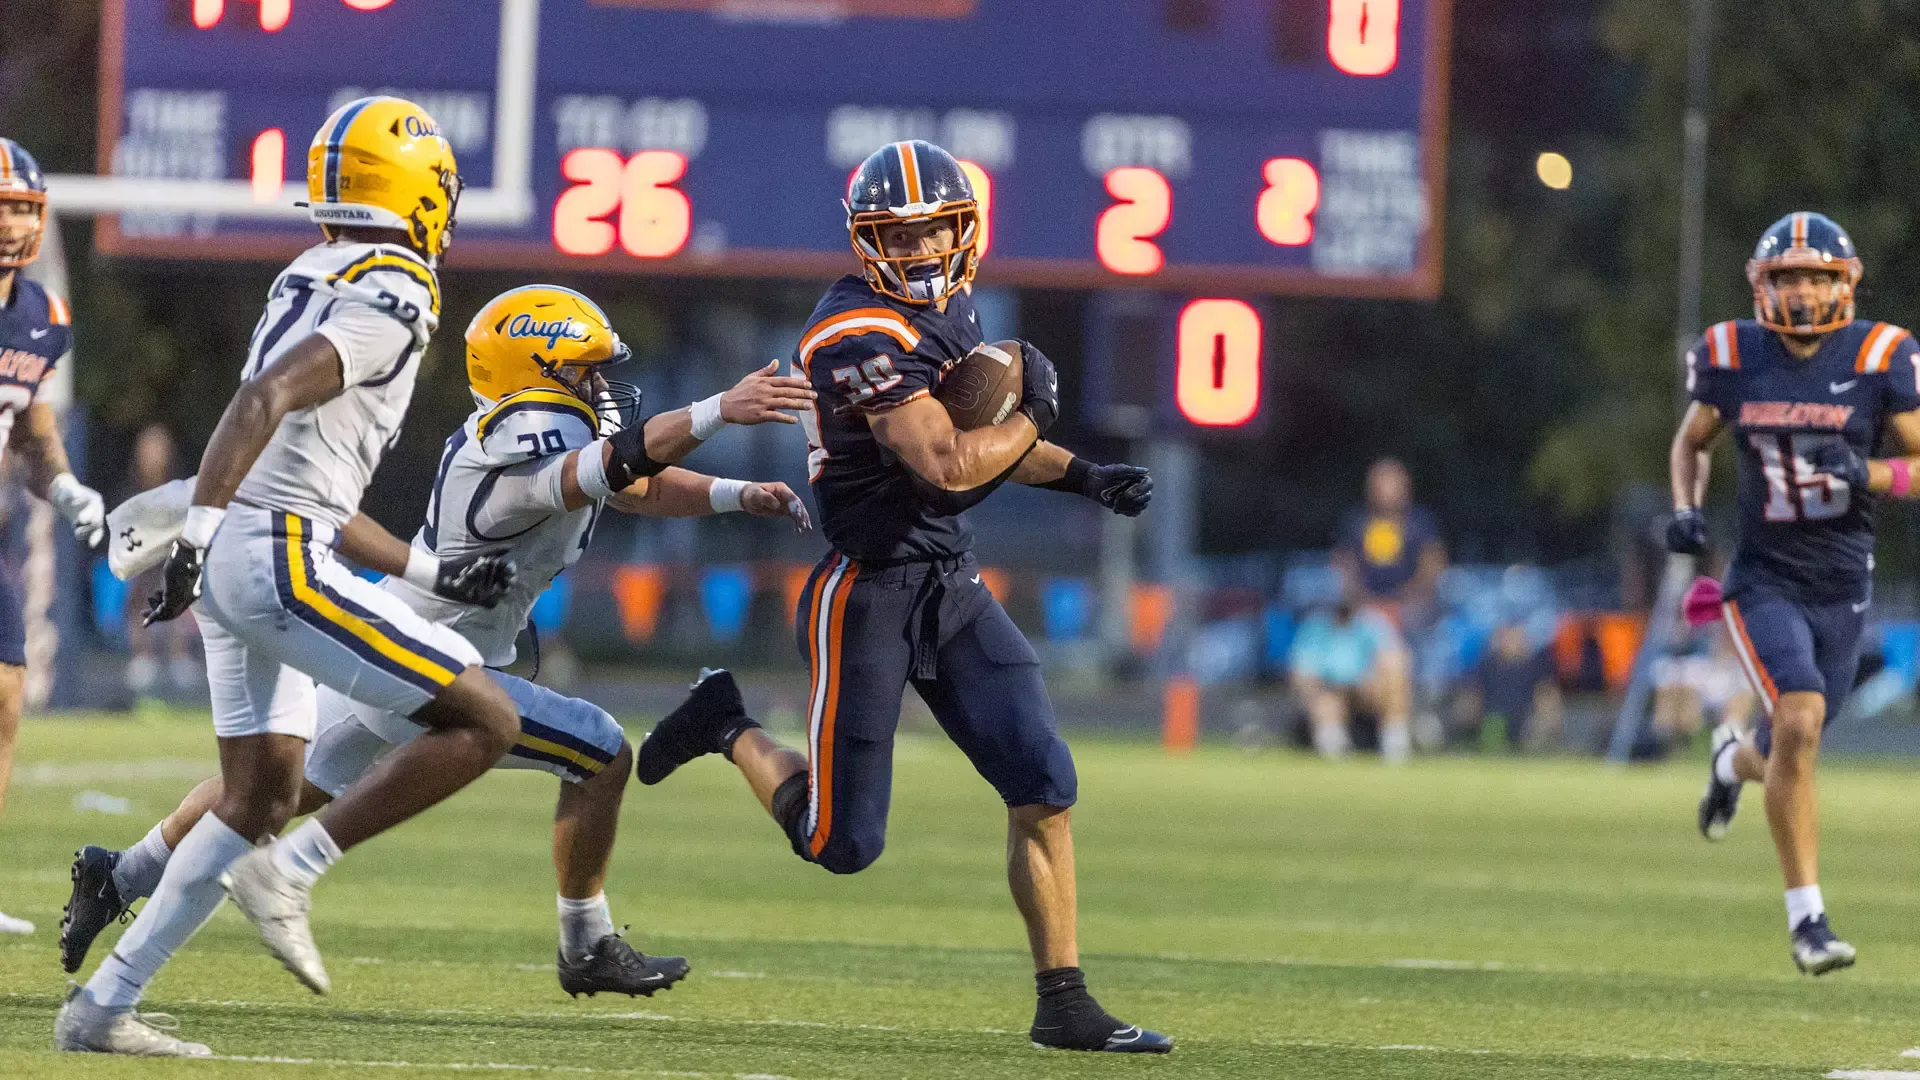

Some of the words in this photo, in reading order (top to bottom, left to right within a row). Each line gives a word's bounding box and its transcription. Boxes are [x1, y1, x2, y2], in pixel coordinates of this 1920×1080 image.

[553, 148, 690, 256] 26
[1097, 167, 1172, 275] 2
[508, 313, 583, 350] Augie
[831, 353, 904, 406] 30
[1176, 298, 1262, 427] 0
[1750, 431, 1850, 521] 15
